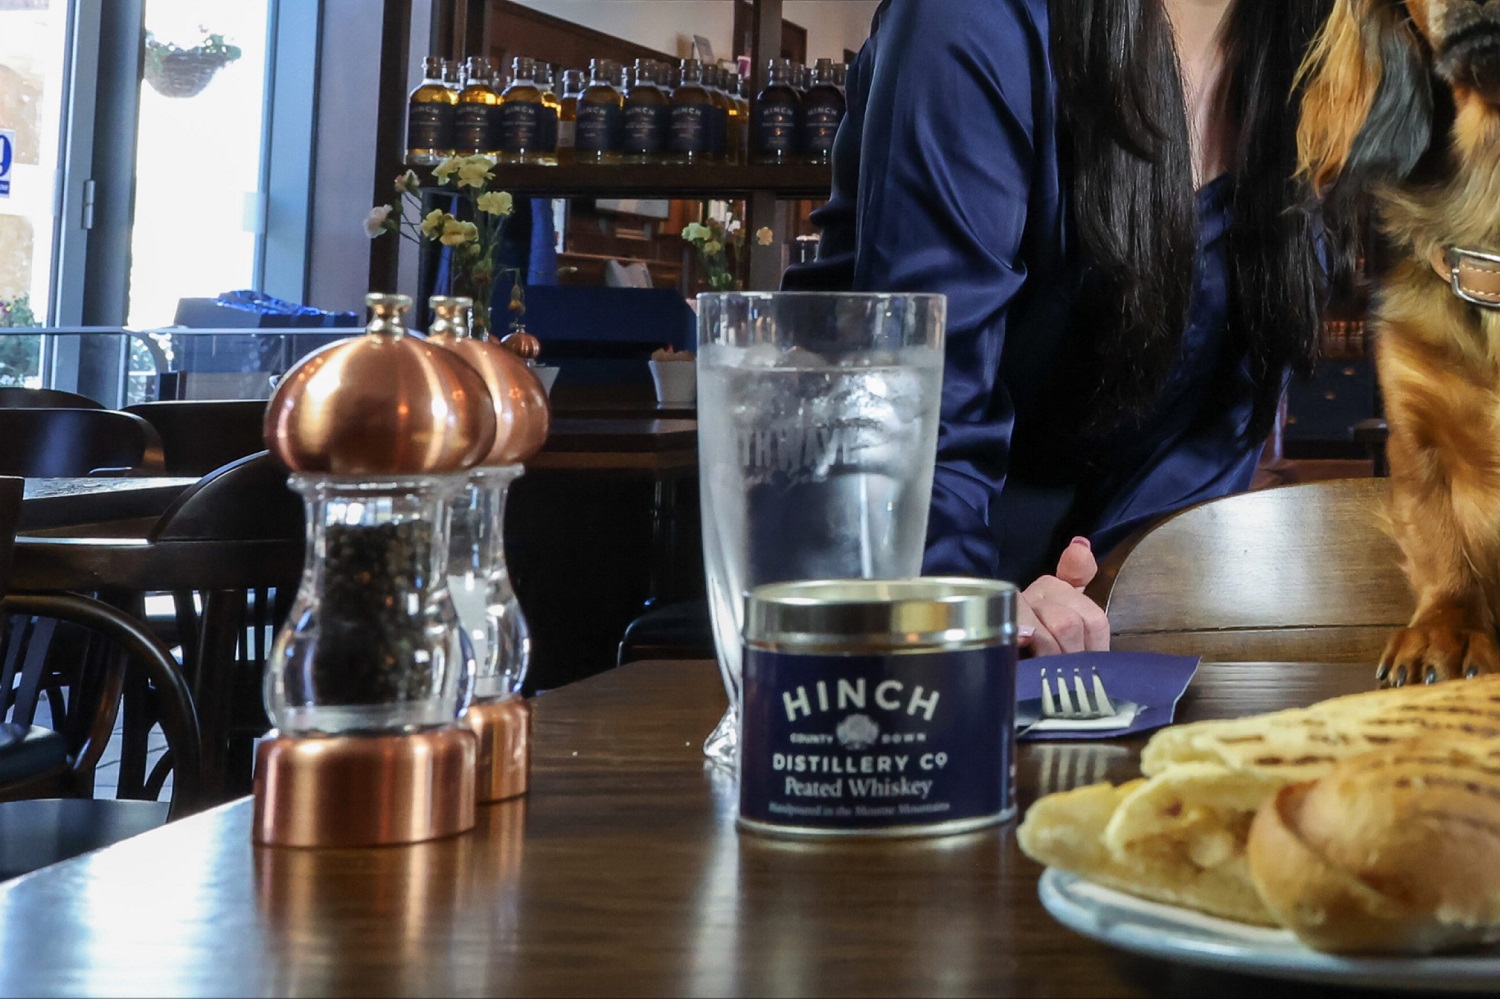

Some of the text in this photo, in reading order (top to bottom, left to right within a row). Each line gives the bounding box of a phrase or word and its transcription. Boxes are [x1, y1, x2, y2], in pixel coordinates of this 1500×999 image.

[782, 678, 940, 722] HINCH
[772, 753, 909, 773] DISTILLERY
[784, 776, 933, 799] Peated Whiskey
